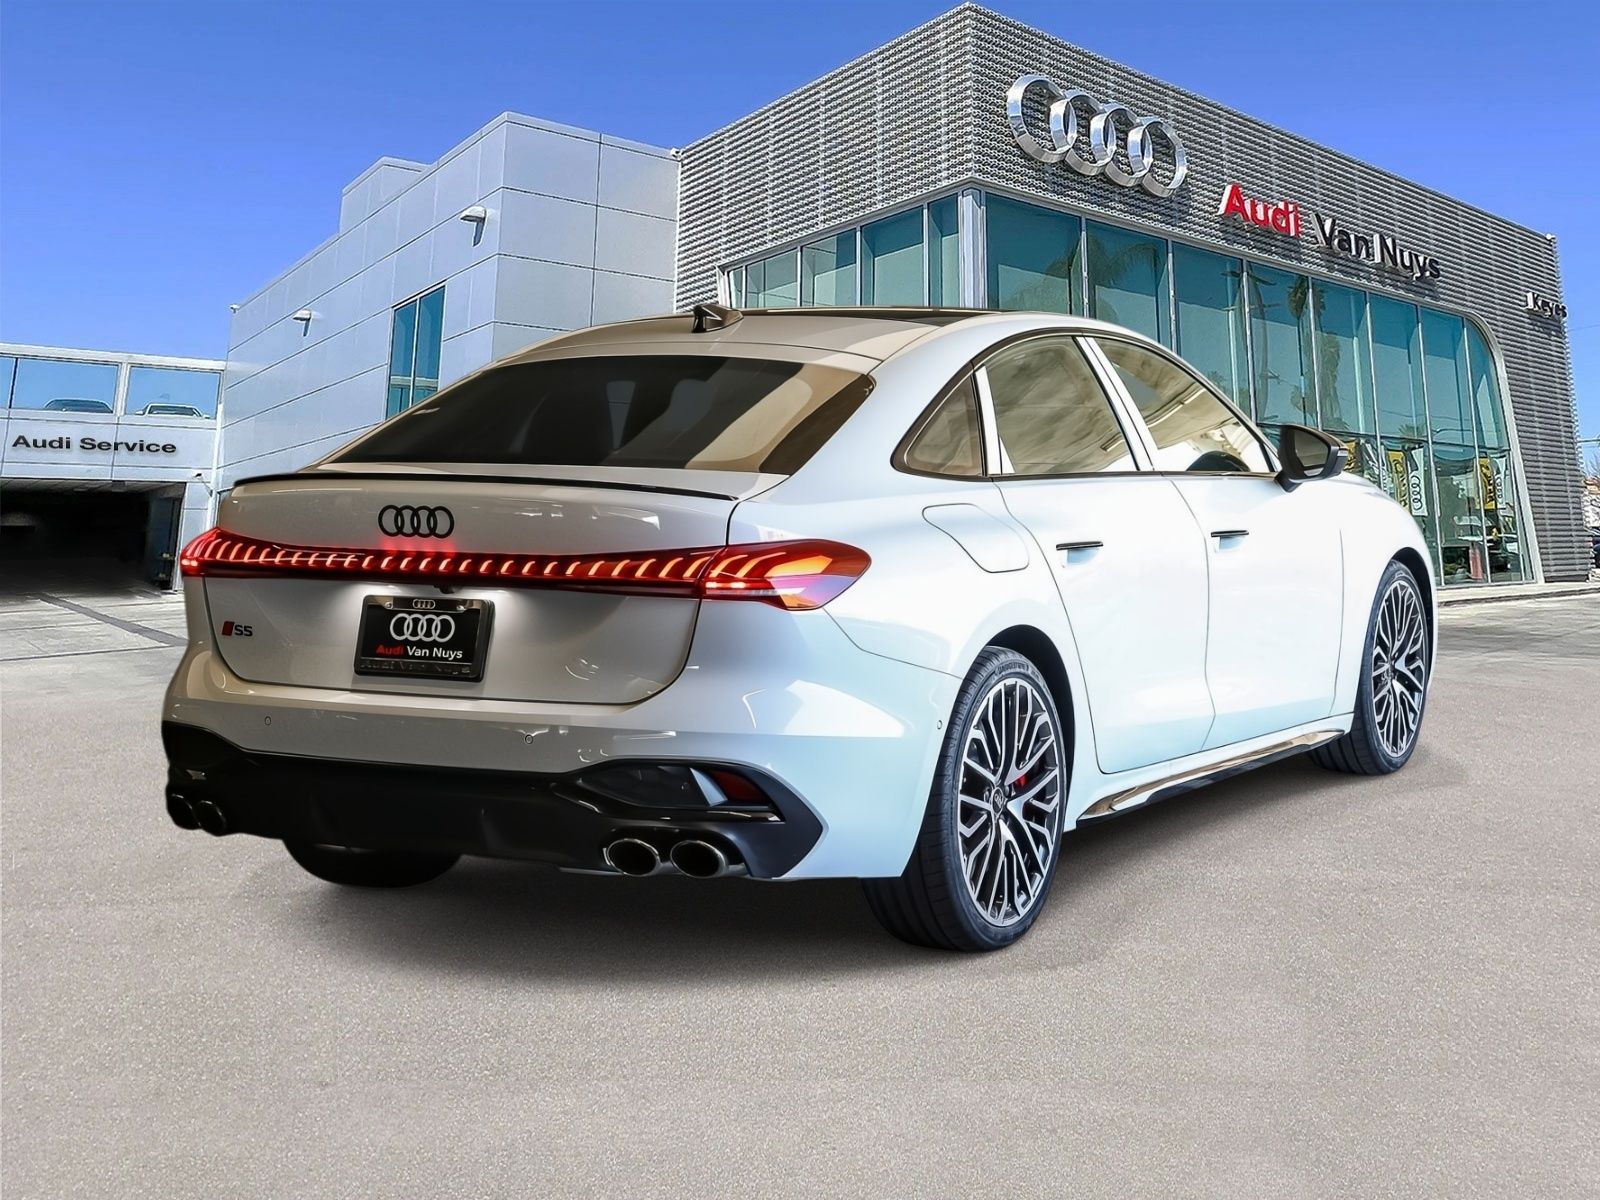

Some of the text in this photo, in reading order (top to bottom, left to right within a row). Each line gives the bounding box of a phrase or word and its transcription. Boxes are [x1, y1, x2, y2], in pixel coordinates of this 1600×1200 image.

[1217, 183, 1441, 281] Audi Van Nuys
[1526, 291, 1568, 318] Keyes
[12, 434, 177, 454] Audi Service
[234, 624, 253, 637] S5
[375, 644, 463, 660] Audi Van Nuys
